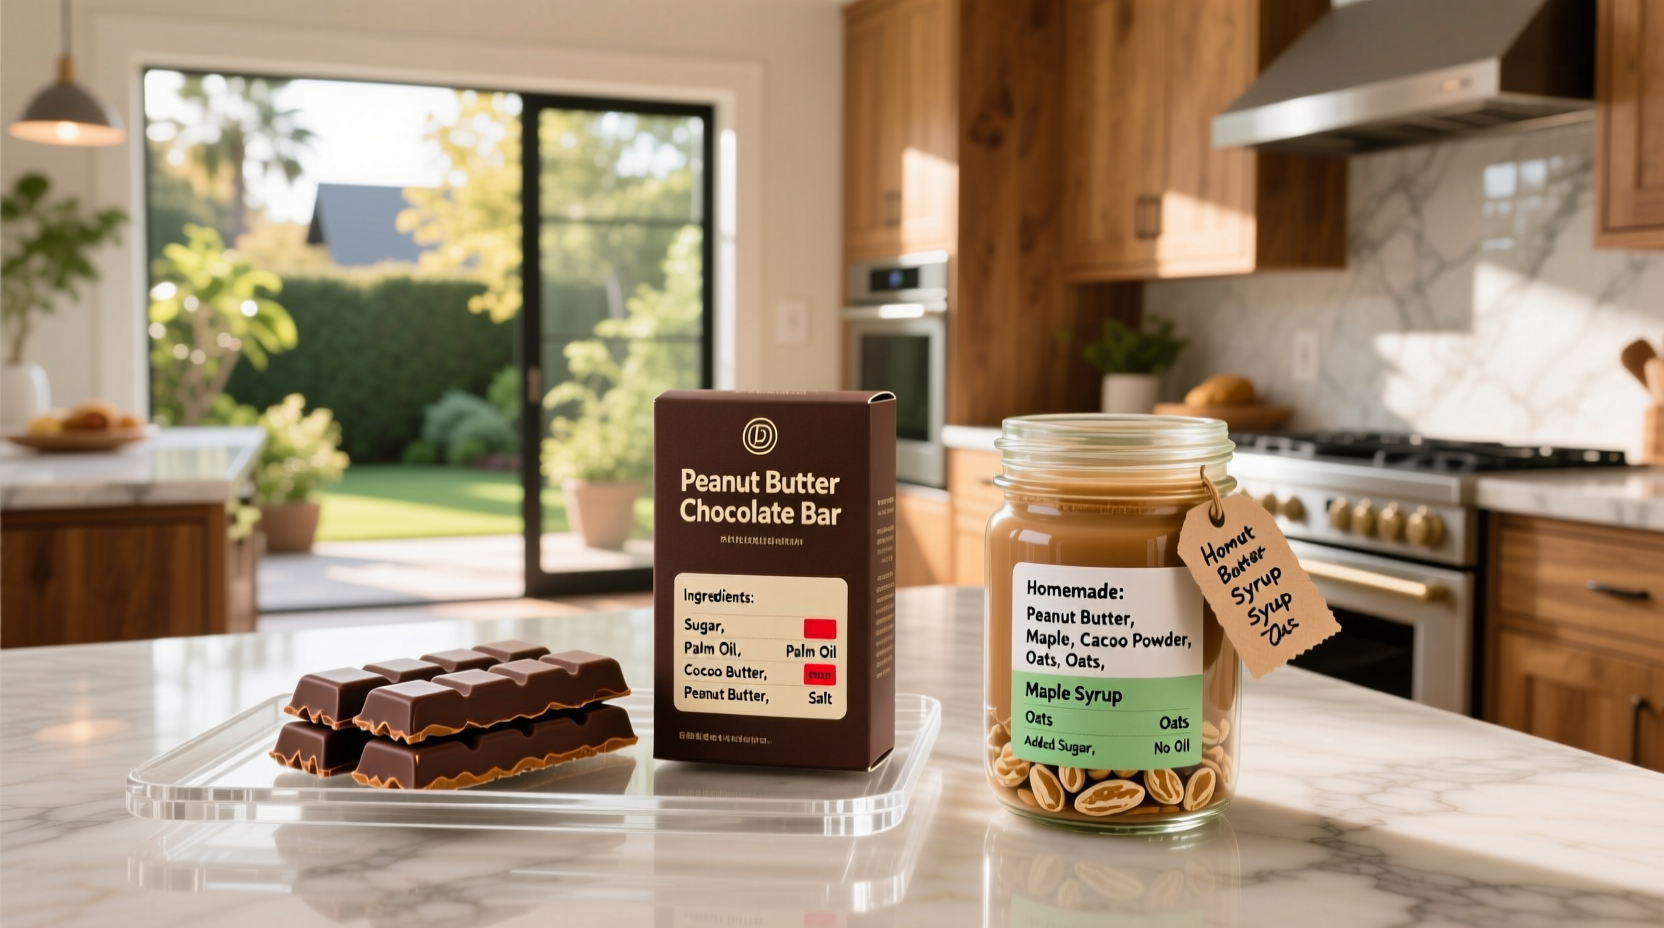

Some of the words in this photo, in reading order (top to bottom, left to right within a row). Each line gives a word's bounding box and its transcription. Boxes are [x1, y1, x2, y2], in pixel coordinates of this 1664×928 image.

[681, 468, 760, 493] Peanut
[765, 470, 840, 494] Butter
[680, 498, 795, 525] Chocolate
[801, 501, 842, 526] Bar
[1027, 580, 1124, 600] Homemade:
[1231, 566, 1282, 606] Syrup
[684, 588, 754, 604] Ingredients:
[1026, 606, 1076, 624] Peanut
[1080, 609, 1135, 628] Butter,
[684, 618, 725, 635] Sugar,
[1026, 628, 1075, 649] Maple,
[1132, 631, 1192, 649] Powder,
[684, 641, 715, 655] Palm
[719, 641, 742, 658] Oil,
[786, 644, 815, 658] Palm
[819, 645, 837, 659] Oil
[1026, 650, 1061, 669] Oats,
[1065, 652, 1105, 671] Oats,
[726, 665, 767, 681] Butter,
[684, 686, 725, 700] Peanut
[727, 688, 769, 704] Butter,
[808, 691, 833, 705] Salt
[1025, 681, 1071, 703] Maple
[1074, 685, 1123, 707] Syrup
[1025, 710, 1053, 727] Oats
[1159, 715, 1190, 730] Oats
[1024, 735, 1055, 751] Added
[1057, 739, 1096, 757] Sugar,
[1154, 741, 1171, 756] No
